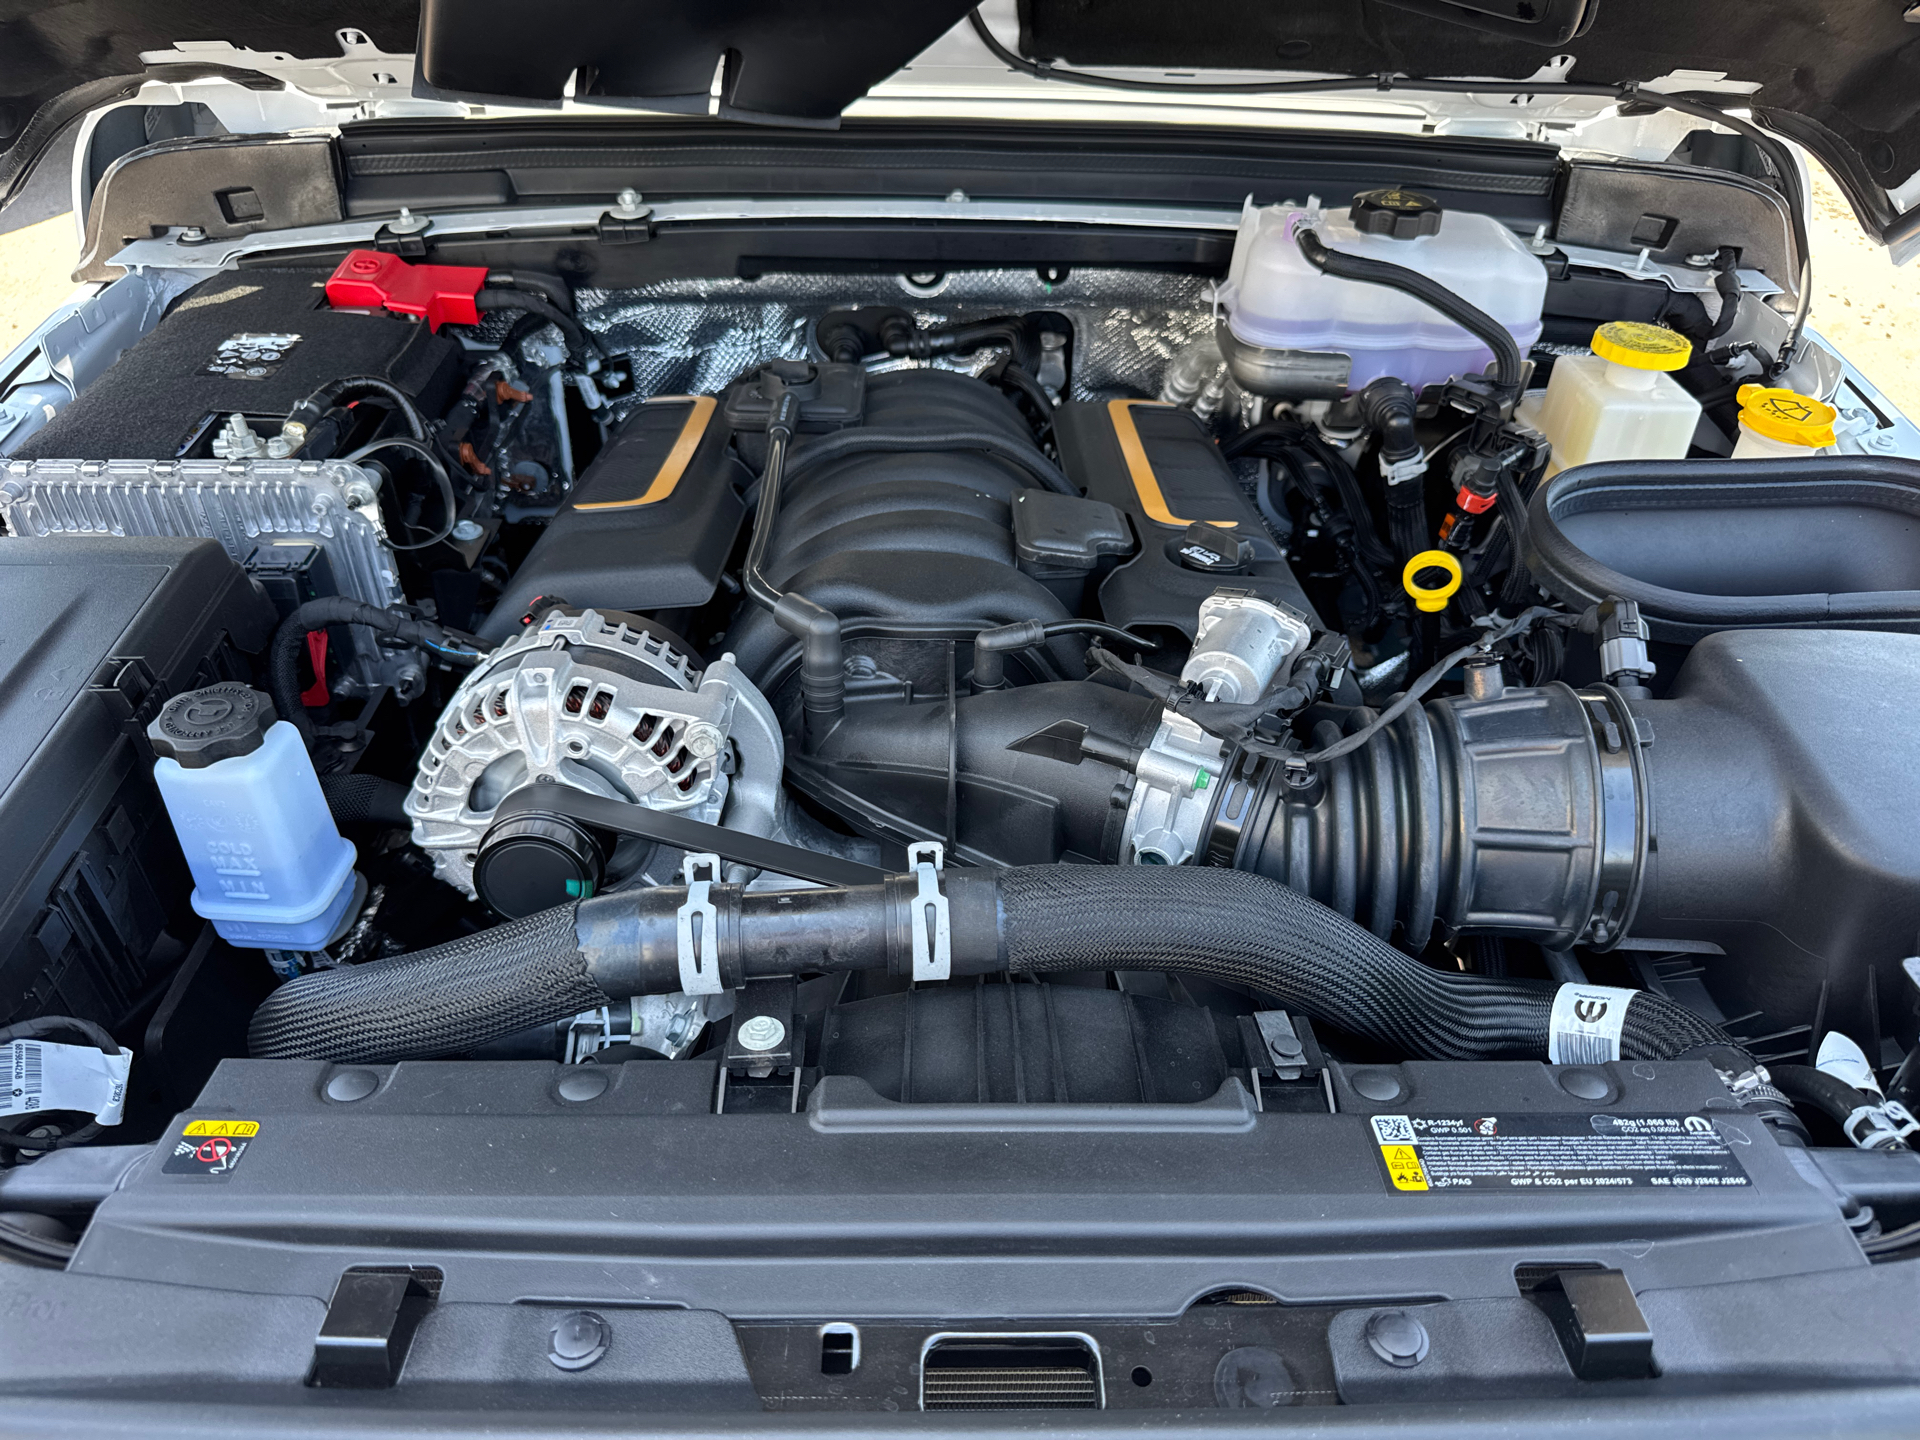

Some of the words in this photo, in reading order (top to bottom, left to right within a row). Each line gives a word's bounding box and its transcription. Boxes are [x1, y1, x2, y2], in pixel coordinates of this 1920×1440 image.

[206, 841, 253, 856] COLD
[209, 855, 259, 870] MAX
[218, 879, 266, 894] MIN
[1612, 1119, 1636, 1127] 482g
[1666, 1119, 1680, 1127] lb)
[1511, 1178, 1532, 1186] GWP
[1650, 1177, 1671, 1185] SAE
